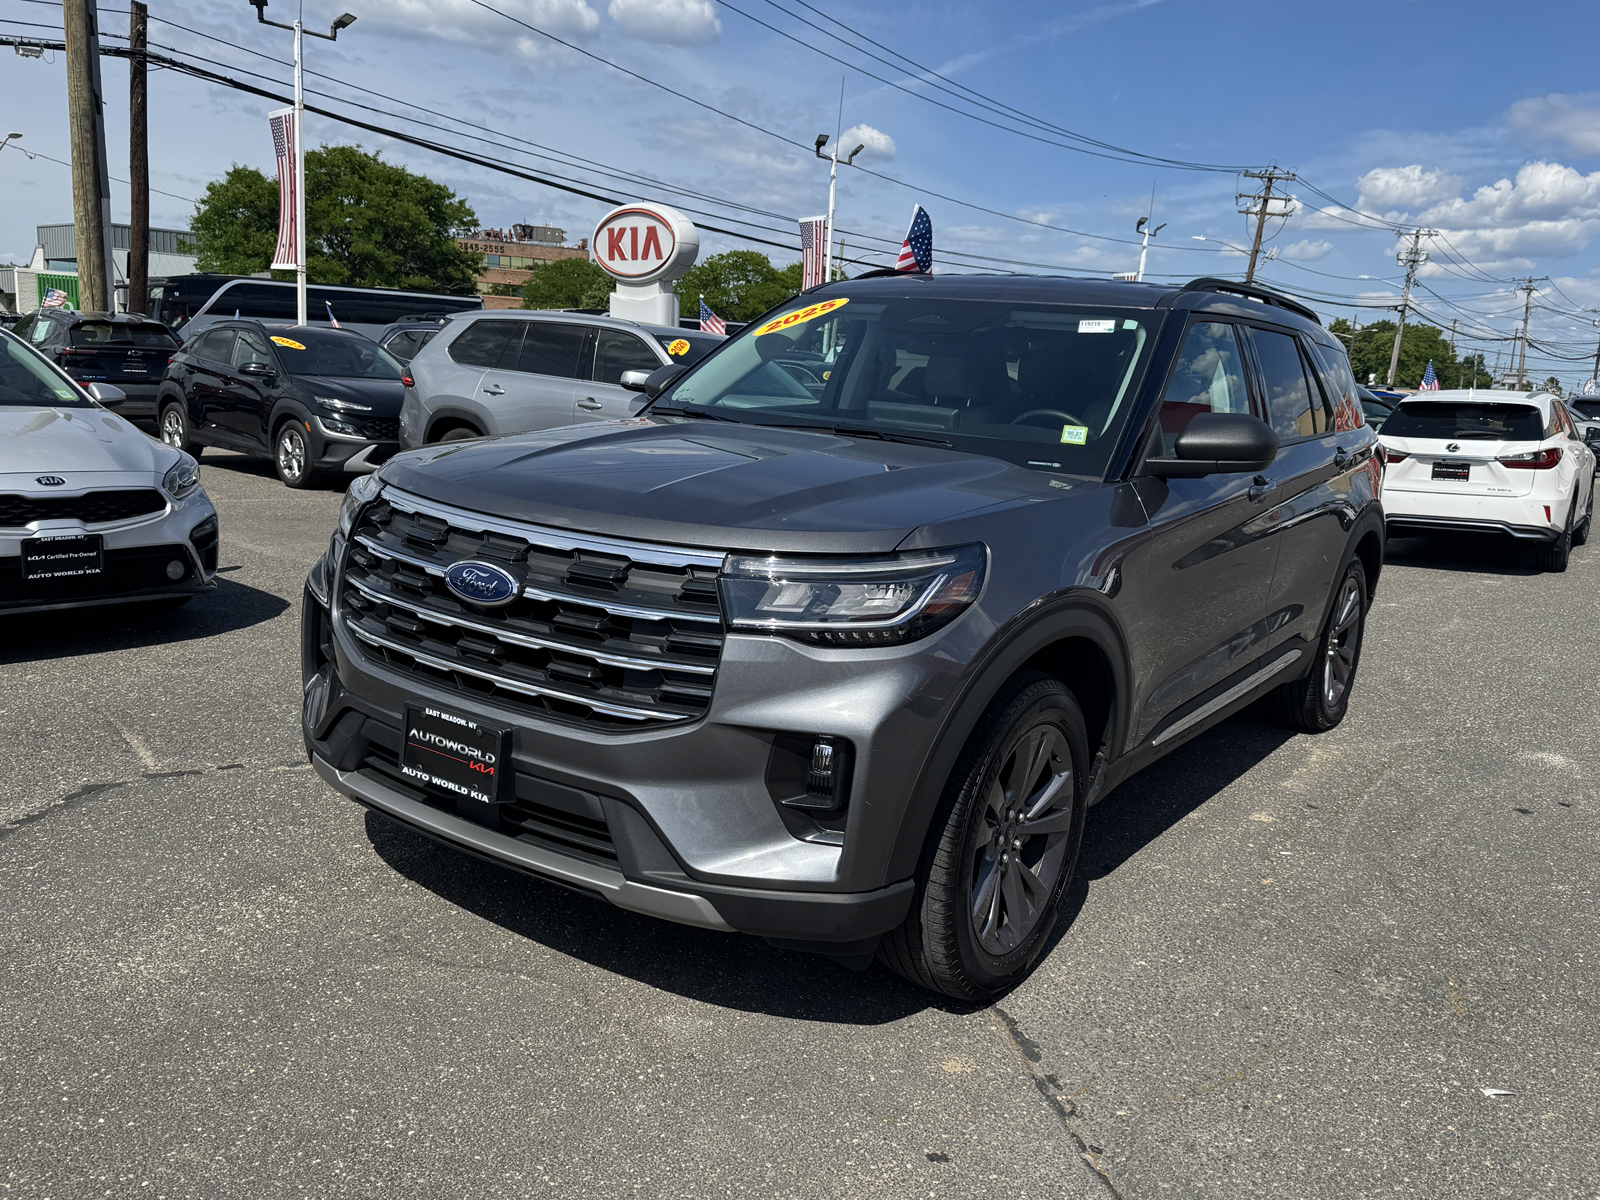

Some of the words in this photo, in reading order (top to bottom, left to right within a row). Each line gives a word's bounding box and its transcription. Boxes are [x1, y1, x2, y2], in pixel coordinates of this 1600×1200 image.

[607, 226, 663, 261] KIA
[765, 300, 836, 333] 2025
[453, 568, 499, 597] Ford
[425, 708, 440, 718] EAST
[468, 721, 478, 730] NY
[408, 728, 496, 764] AUTOWORLD
[469, 760, 495, 776] KIA
[402, 766, 430, 782] AUTO
[432, 776, 468, 796] WORLD
[470, 790, 490, 804] KIA
